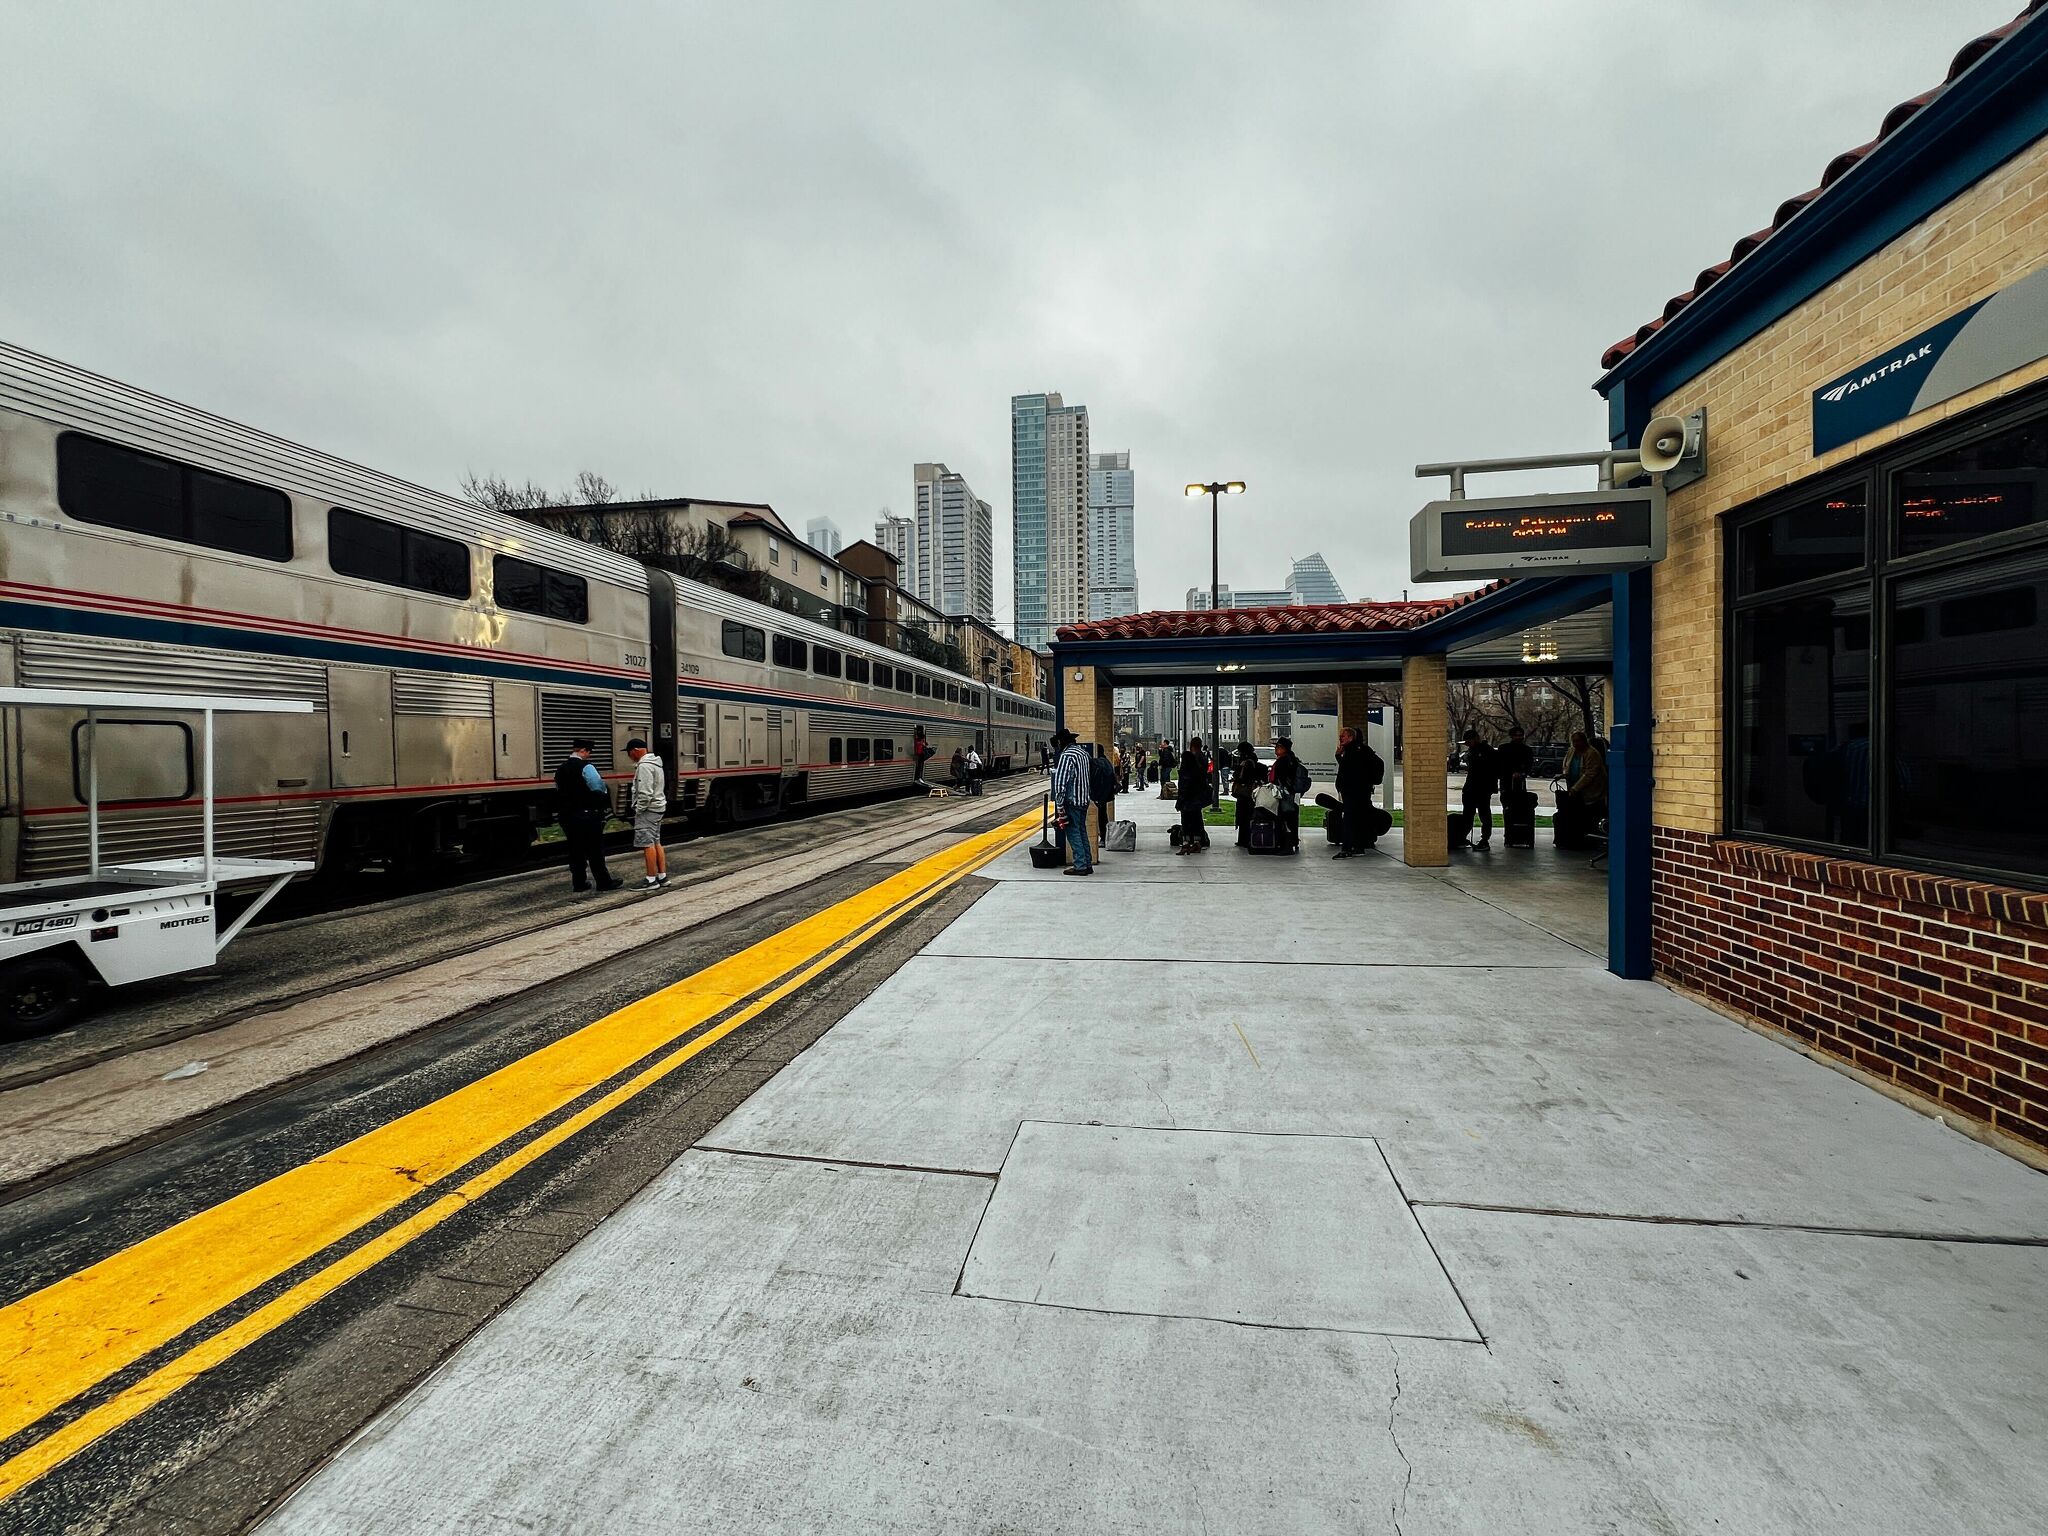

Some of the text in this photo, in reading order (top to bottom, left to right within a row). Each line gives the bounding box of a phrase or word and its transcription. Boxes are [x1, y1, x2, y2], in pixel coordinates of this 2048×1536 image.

[1848, 343, 1932, 394] AMTRAK
[624, 653, 647, 668] 31027
[680, 663, 700, 675] 34109
[17, 916, 75, 933] MC 480
[160, 915, 210, 930] MOTREC
